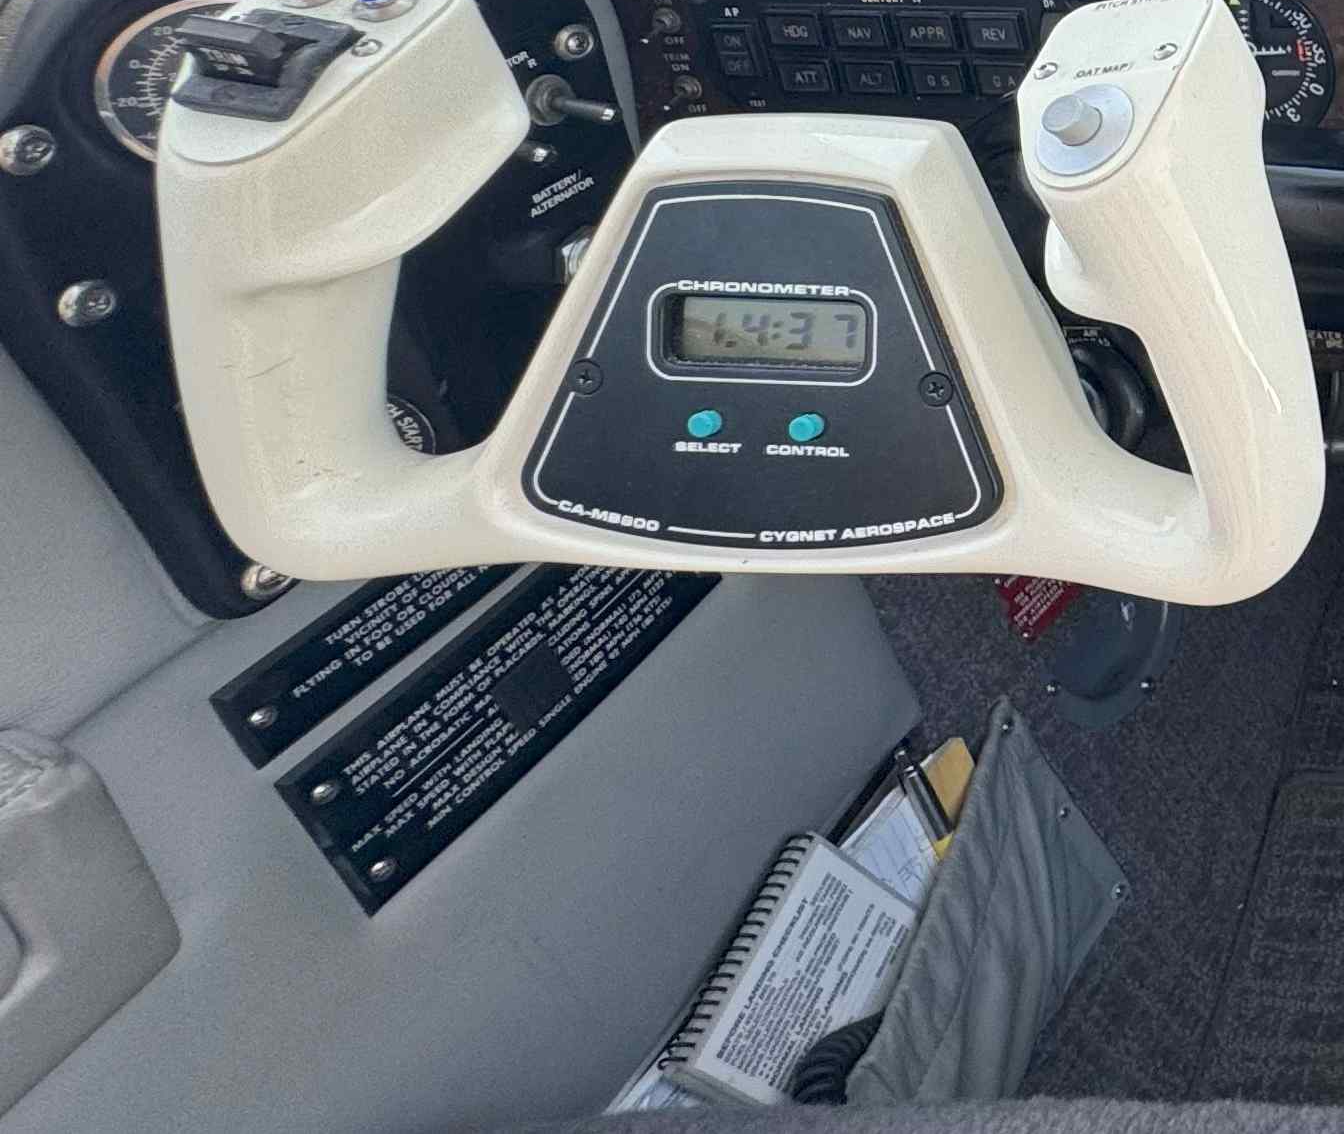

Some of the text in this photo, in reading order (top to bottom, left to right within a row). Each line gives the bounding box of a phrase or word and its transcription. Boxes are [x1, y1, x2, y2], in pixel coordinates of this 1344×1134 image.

[847, 27, 872, 40] NAV
[909, 27, 946, 41] APPR
[982, 27, 1006, 42] REV
[530, 177, 595, 218] ALTERNATOR
[532, 169, 582, 204] BATTERY/
[678, 278, 851, 297] CHRONOMETER
[674, 441, 851, 458] SELECT CONTROL
[759, 528, 838, 545] CYGNET
[840, 512, 956, 541] AEROSPACE
[325, 580, 412, 645] TURN STROBE
[344, 587, 419, 644] VICINITY OF
[292, 658, 343, 699] FLYING
[343, 645, 362, 660] IN
[363, 621, 393, 646] FOG
